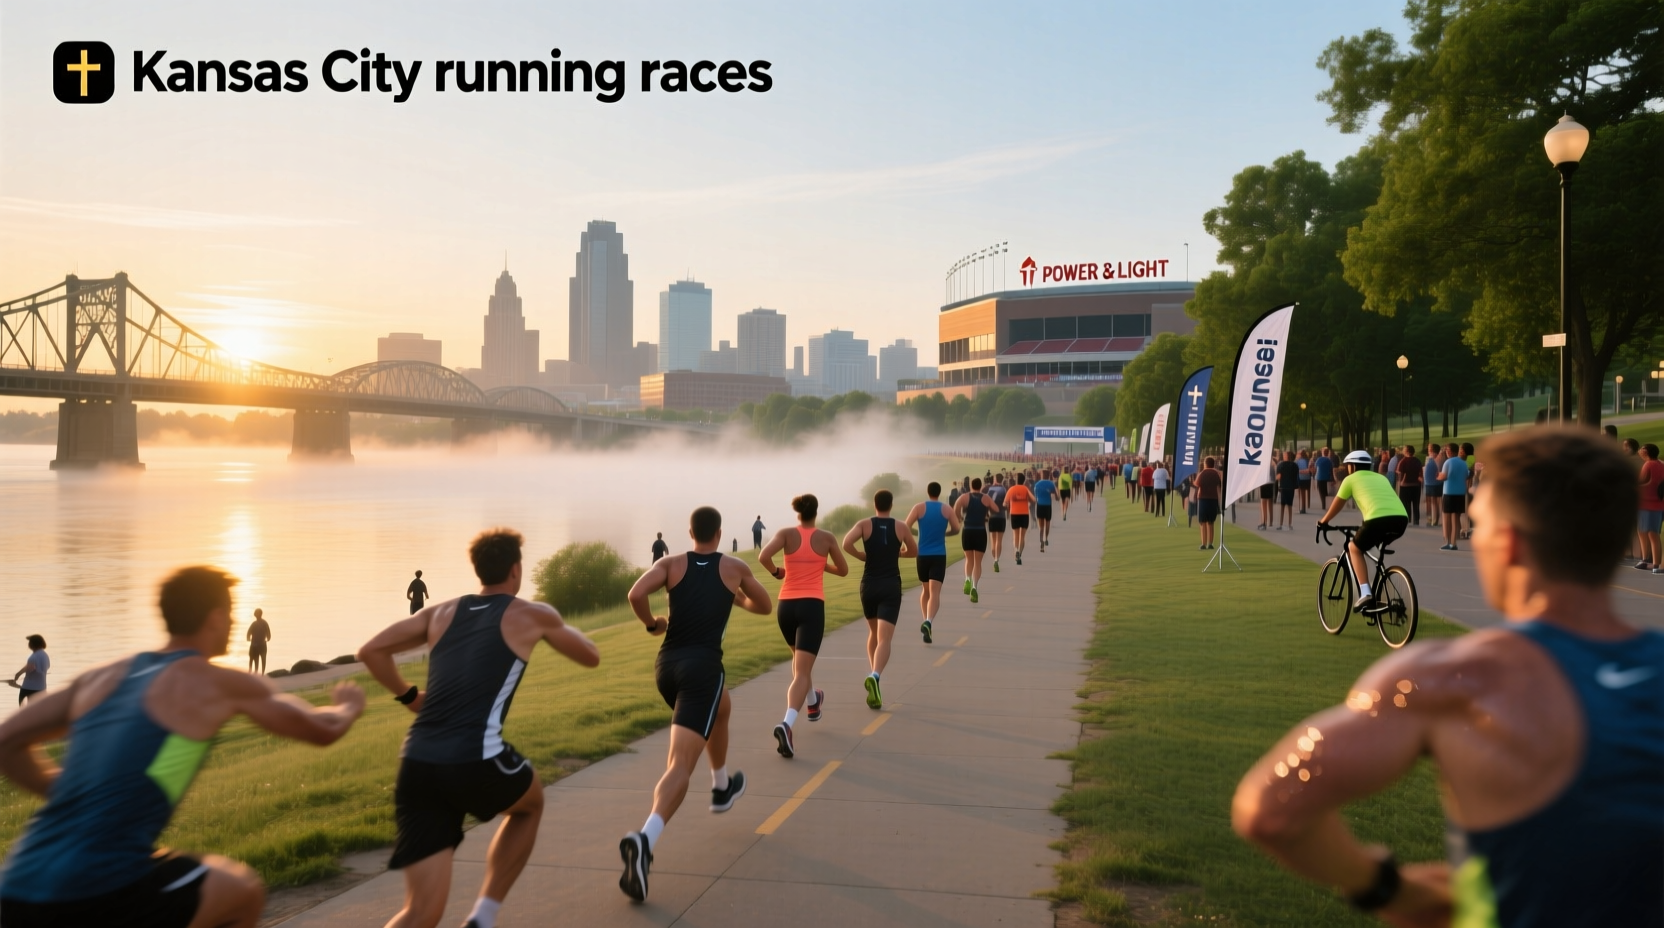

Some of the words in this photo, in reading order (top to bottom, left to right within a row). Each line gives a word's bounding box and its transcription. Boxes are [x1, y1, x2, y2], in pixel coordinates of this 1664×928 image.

[1042, 263, 1098, 282] POWER
[1102, 262, 1115, 280] &
[1117, 260, 1169, 279] LIGHT
